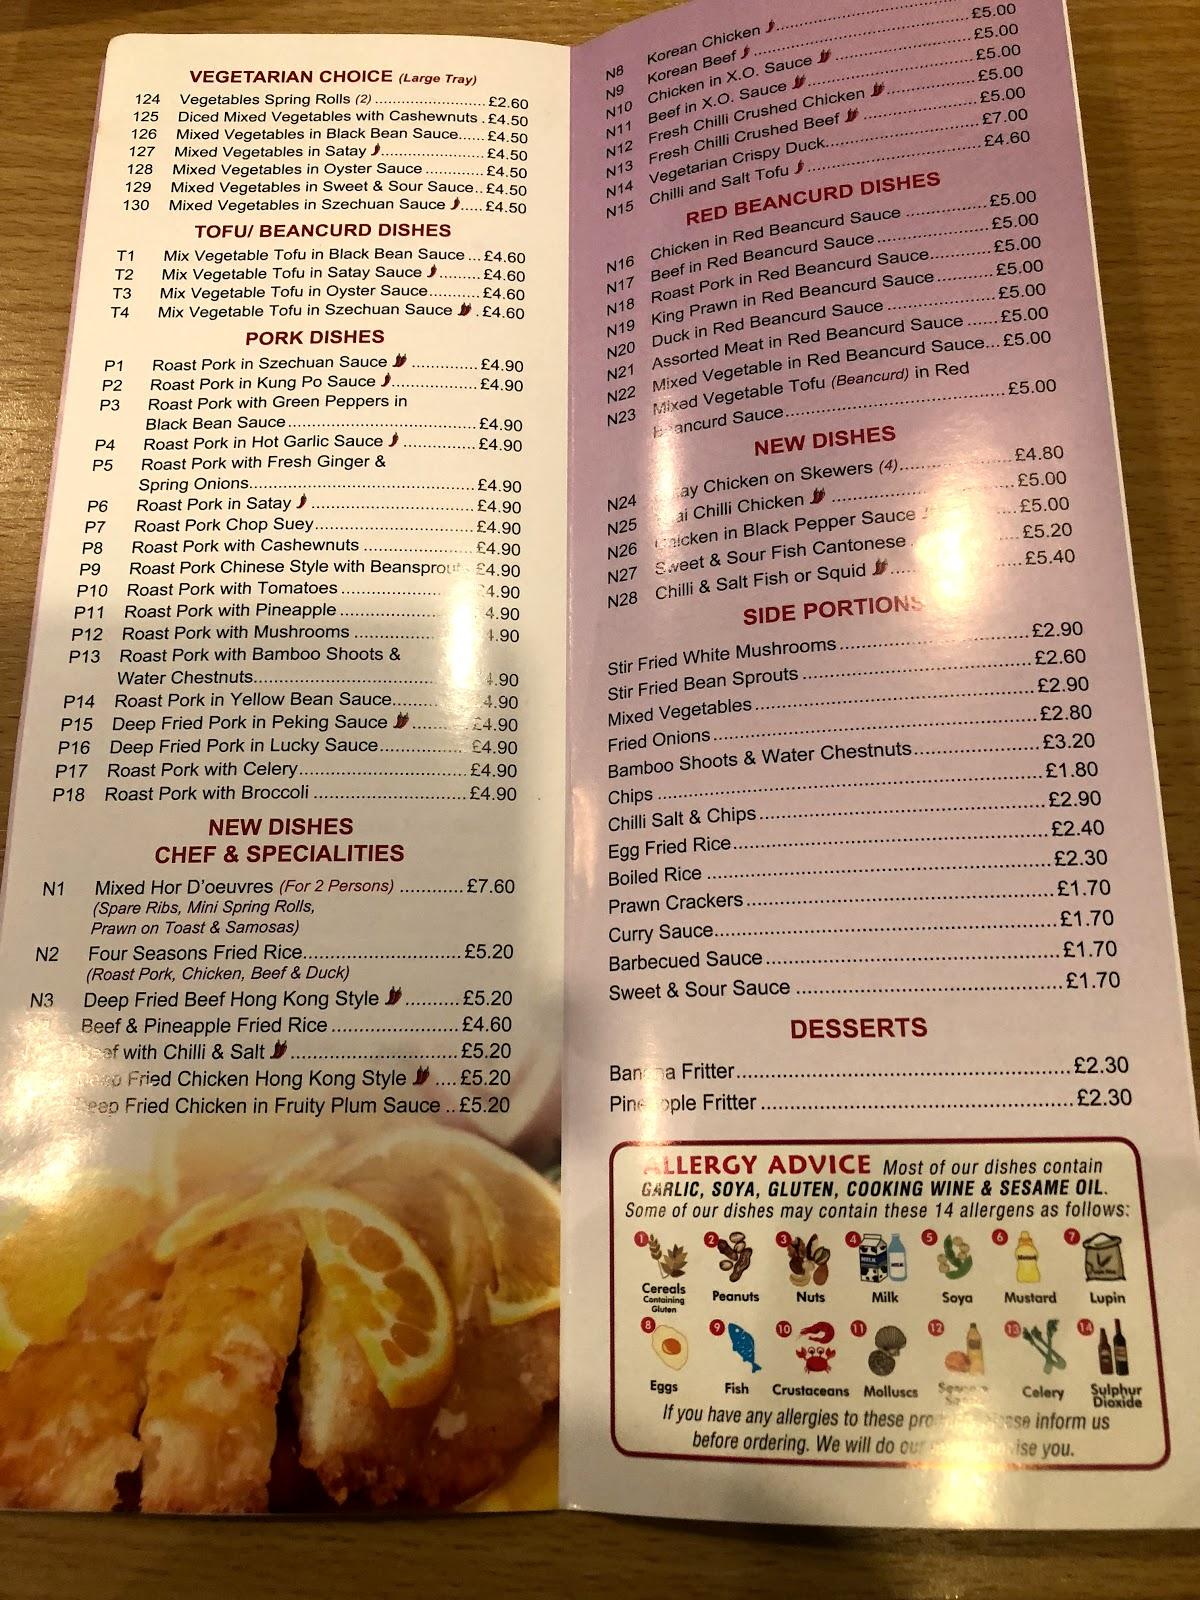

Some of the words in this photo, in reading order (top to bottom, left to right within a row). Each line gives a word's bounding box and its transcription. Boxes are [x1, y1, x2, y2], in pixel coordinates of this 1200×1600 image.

[606, 65, 624, 81] N8
[648, 43, 697, 65] Korean
[702, 27, 760, 48] Chicken
[190, 70, 313, 83] VEGETARIAN
[319, 70, 392, 83] CHOICE
[399, 73, 441, 85] (Large
[445, 74, 477, 86] Tray)
[136, 93, 160, 104] 124
[180, 94, 260, 107] Vegetables
[265, 94, 310, 107] Spring
[316, 94, 350, 104] Rolls
[355, 94, 371, 105] (2)
[488, 96, 528, 110] £2.60
[133, 111, 159, 122] 125
[178, 111, 219, 122] Diced
[224, 111, 266, 122] Mixed
[271, 111, 351, 125] Vegetables
[356, 110, 384, 121] with
[389, 110, 478, 123] Cashewnuts
[488, 113, 528, 127] £4.50
[606, 140, 633, 159] N12
[649, 124, 688, 144] Fresh
[694, 113, 728, 131] Chilli
[734, 99, 797, 122] Crushed
[803, 90, 865, 108] Chicken
[978, 65, 1023, 81] £5.00
[687, 205, 728, 226] RED
[735, 184, 853, 216] BEANCURD
[860, 172, 940, 195] DISHES
[195, 225, 254, 238] TOFU/
[259, 224, 371, 238] BEANCURD
[378, 223, 451, 237] DISHES
[607, 319, 635, 338] N19
[652, 310, 684, 325] King
[690, 300, 737, 317] Prawn
[743, 295, 756, 307] in
[762, 287, 793, 304] Red
[800, 277, 876, 298] Beancurd
[882, 273, 934, 287] Sauce
[996, 259, 1043, 276] £5.00
[110, 306, 129, 318] T4
[158, 306, 184, 318] Mix
[189, 305, 264, 320] Vegetable
[269, 304, 302, 316] Tofu
[307, 304, 320, 316] in
[325, 303, 399, 315] Szechuan
[405, 303, 452, 316] Sauce
[482, 306, 525, 320] £4.60
[246, 331, 303, 346] PORK
[310, 329, 384, 344] DISHES
[104, 360, 123, 372] P1
[153, 359, 197, 371] Roast
[202, 358, 236, 370] Pork
[241, 358, 253, 369] in
[259, 356, 334, 369] Szechuan
[339, 356, 387, 368] Sauce
[481, 358, 524, 373] £4.90
[755, 435, 805, 456] NEW
[813, 425, 896, 449] DISHES
[608, 591, 638, 609] N28
[656, 581, 693, 600] Chilli
[699, 580, 710, 593] &
[716, 575, 748, 591] Salt
[754, 571, 788, 587] Fish
[794, 571, 812, 583] or
[817, 563, 866, 582] Squid
[1025, 549, 1075, 565] £5.40
[744, 604, 796, 625] SIDE
[69, 650, 100, 664] P13
[120, 649, 167, 663] Roast
[172, 648, 209, 662] Pork
[214, 647, 246, 661] with
[252, 647, 320, 661] Bamboo
[326, 647, 383, 661] Shoots
[389, 647, 401, 661] &
[608, 660, 633, 676] Stir
[638, 652, 677, 671] Fried
[683, 648, 730, 664] White
[736, 640, 836, 659] Mushrooms
[1032, 621, 1083, 638] £2.90
[53, 787, 85, 802] P18
[105, 787, 154, 801] Roast
[159, 786, 197, 800] Pork
[202, 785, 235, 800] with
[242, 785, 309, 799] Broccoli
[470, 786, 517, 801] £4.90
[209, 818, 262, 836] NEW
[269, 818, 353, 835] DISHES
[155, 846, 216, 864] CHEF
[223, 845, 239, 863] &
[246, 844, 404, 863] SPECIALITIES
[609, 868, 658, 886] Boiled
[665, 866, 702, 882] Rice
[1054, 849, 1107, 866] £2.30
[43, 881, 64, 896] N1
[95, 880, 145, 895] Mixed
[151, 880, 182, 895] Hor
[280, 879, 311, 896] (For
[314, 879, 324, 892] 2
[328, 879, 394, 895] Persons)
[467, 878, 515, 894] £7.60
[93, 902, 141, 918] (Spare
[145, 901, 181, 916] Ribs,
[187, 900, 219, 913] Mini
[222, 900, 270, 916] Spring
[274, 899, 314, 914] Rolls,
[609, 983, 661, 1001] Sweet
[667, 982, 679, 998] &
[685, 981, 727, 997] Sour
[733, 979, 790, 996] Sauce
[1066, 971, 1120, 989] £1.70
[30, 993, 53, 1008] N3
[84, 992, 129, 1011] Deep
[135, 992, 179, 1007] Fried
[185, 991, 226, 1007] Beef
[231, 991, 277, 1010] Hong
[284, 990, 329, 1010] Kong
[335, 990, 379, 1010] Style
[463, 990, 512, 1006] £5.20
[791, 1017, 928, 1039] DESSERTS
[644, 1155, 758, 1175] LLERGY
[768, 1154, 870, 1174] ADVICE
[883, 1160, 924, 1175] Most
[929, 1159, 946, 1175] of
[951, 1163, 979, 1175] our
[984, 1159, 1038, 1175] dishes
[1043, 1158, 1103, 1174] contain
[625, 1202, 666, 1218] Some
[672, 1202, 688, 1218] of
[693, 1206, 719, 1218] our
[724, 1202, 774, 1218] dishes
[780, 1206, 813, 1222] may
[819, 1203, 877, 1218] contain
[885, 1202, 927, 1218] these
[936, 1202, 953, 1218] 14
[960, 1202, 1034, 1221] allergens
[1040, 1204, 1059, 1217] as
[1066, 1201, 1129, 1217] follows:
[642, 1283, 686, 1294] Cereals
[712, 1290, 760, 1302] Peanuts
[796, 1291, 825, 1303] Nuts
[872, 1291, 899, 1303] Milk
[643, 1295, 685, 1306] Containing
[942, 1291, 973, 1306] Soya
[1004, 1291, 1057, 1304] Mustard
[1090, 1291, 1126, 1307] Lupin
[651, 1305, 677, 1313] Gluten
[650, 1380, 678, 1394] Eggs
[725, 1382, 749, 1394] Fish
[772, 1384, 850, 1397] Crustaceans
[864, 1385, 918, 1398] Molluscs
[1022, 1385, 1064, 1401] Celery
[1090, 1383, 1142, 1398] Sulphur
[1093, 1396, 1143, 1409] Dioxide
